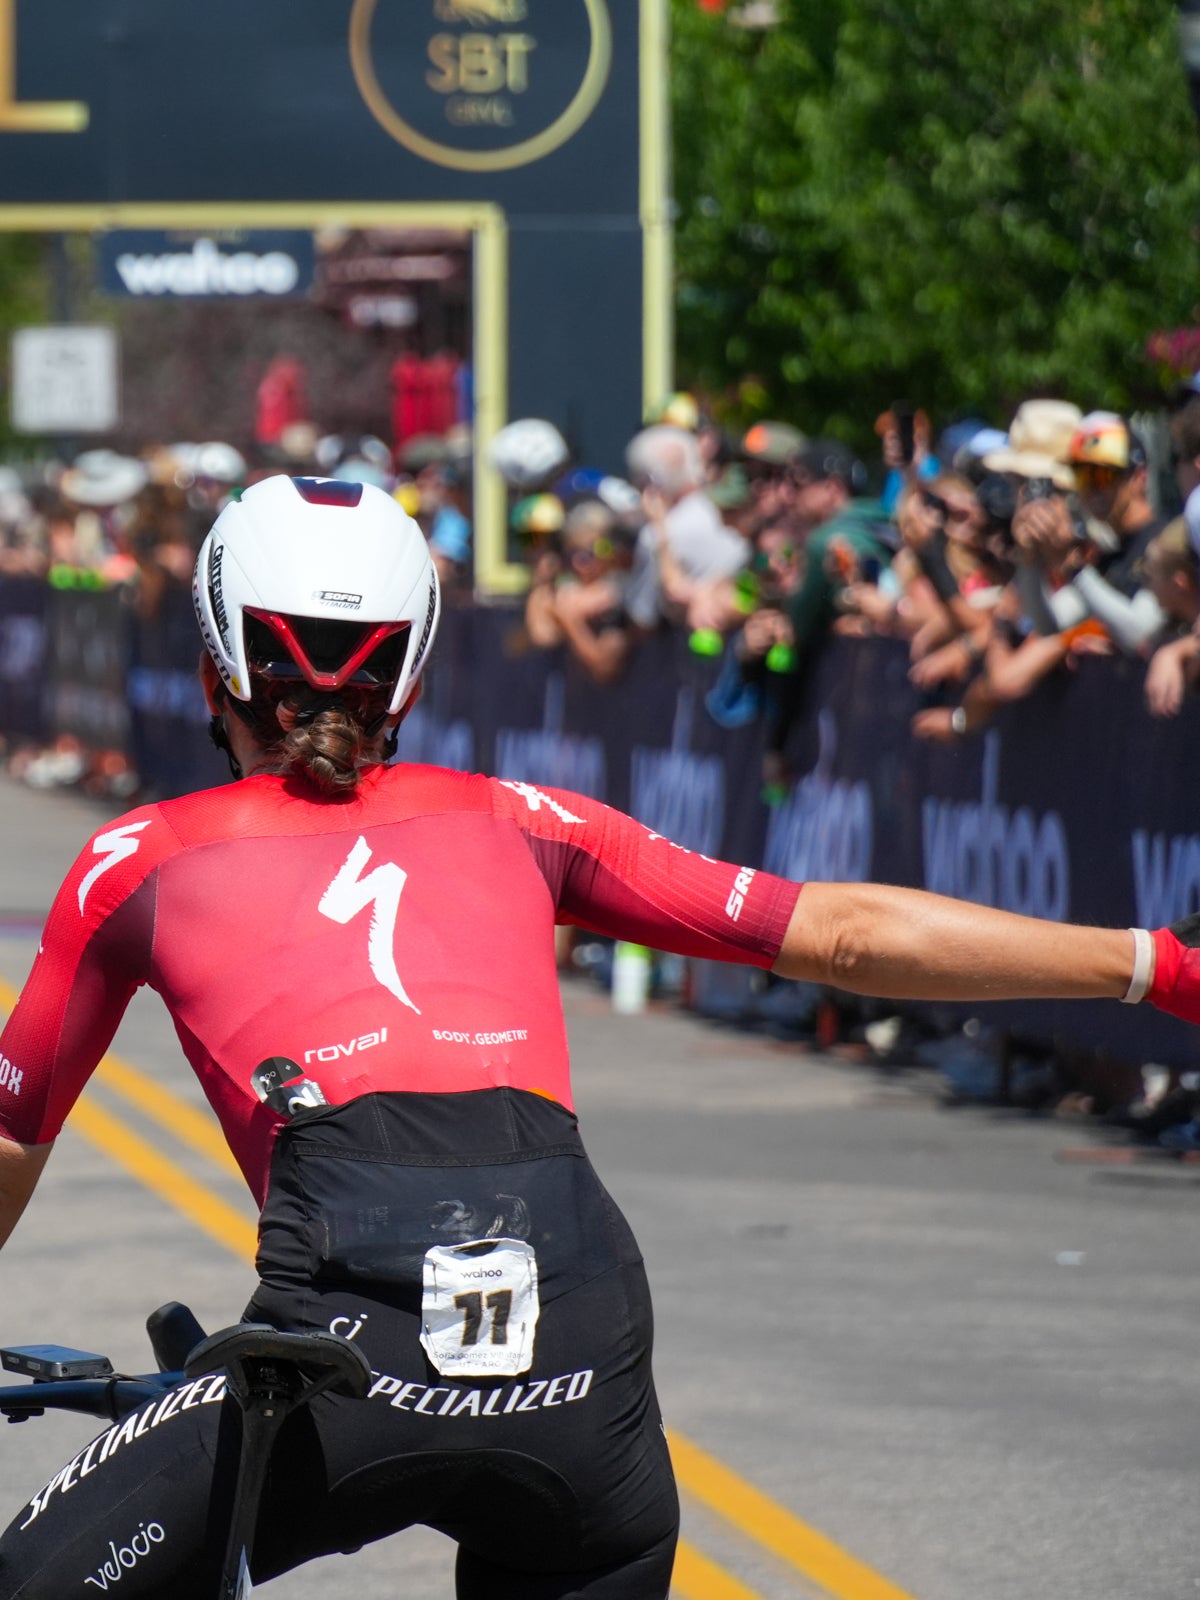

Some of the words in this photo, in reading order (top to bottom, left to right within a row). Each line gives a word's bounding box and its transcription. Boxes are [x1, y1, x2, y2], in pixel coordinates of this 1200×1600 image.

[426, 32, 538, 94] SBT
[116, 238, 298, 294] wahoo
[323, 592, 362, 604] SOFIA
[304, 1027, 388, 1064] roval
[460, 1266, 502, 1278] wahoo
[453, 1289, 513, 1347] 11
[367, 1369, 594, 1417] PECIALIZED
[84, 1521, 166, 1590] velocio
